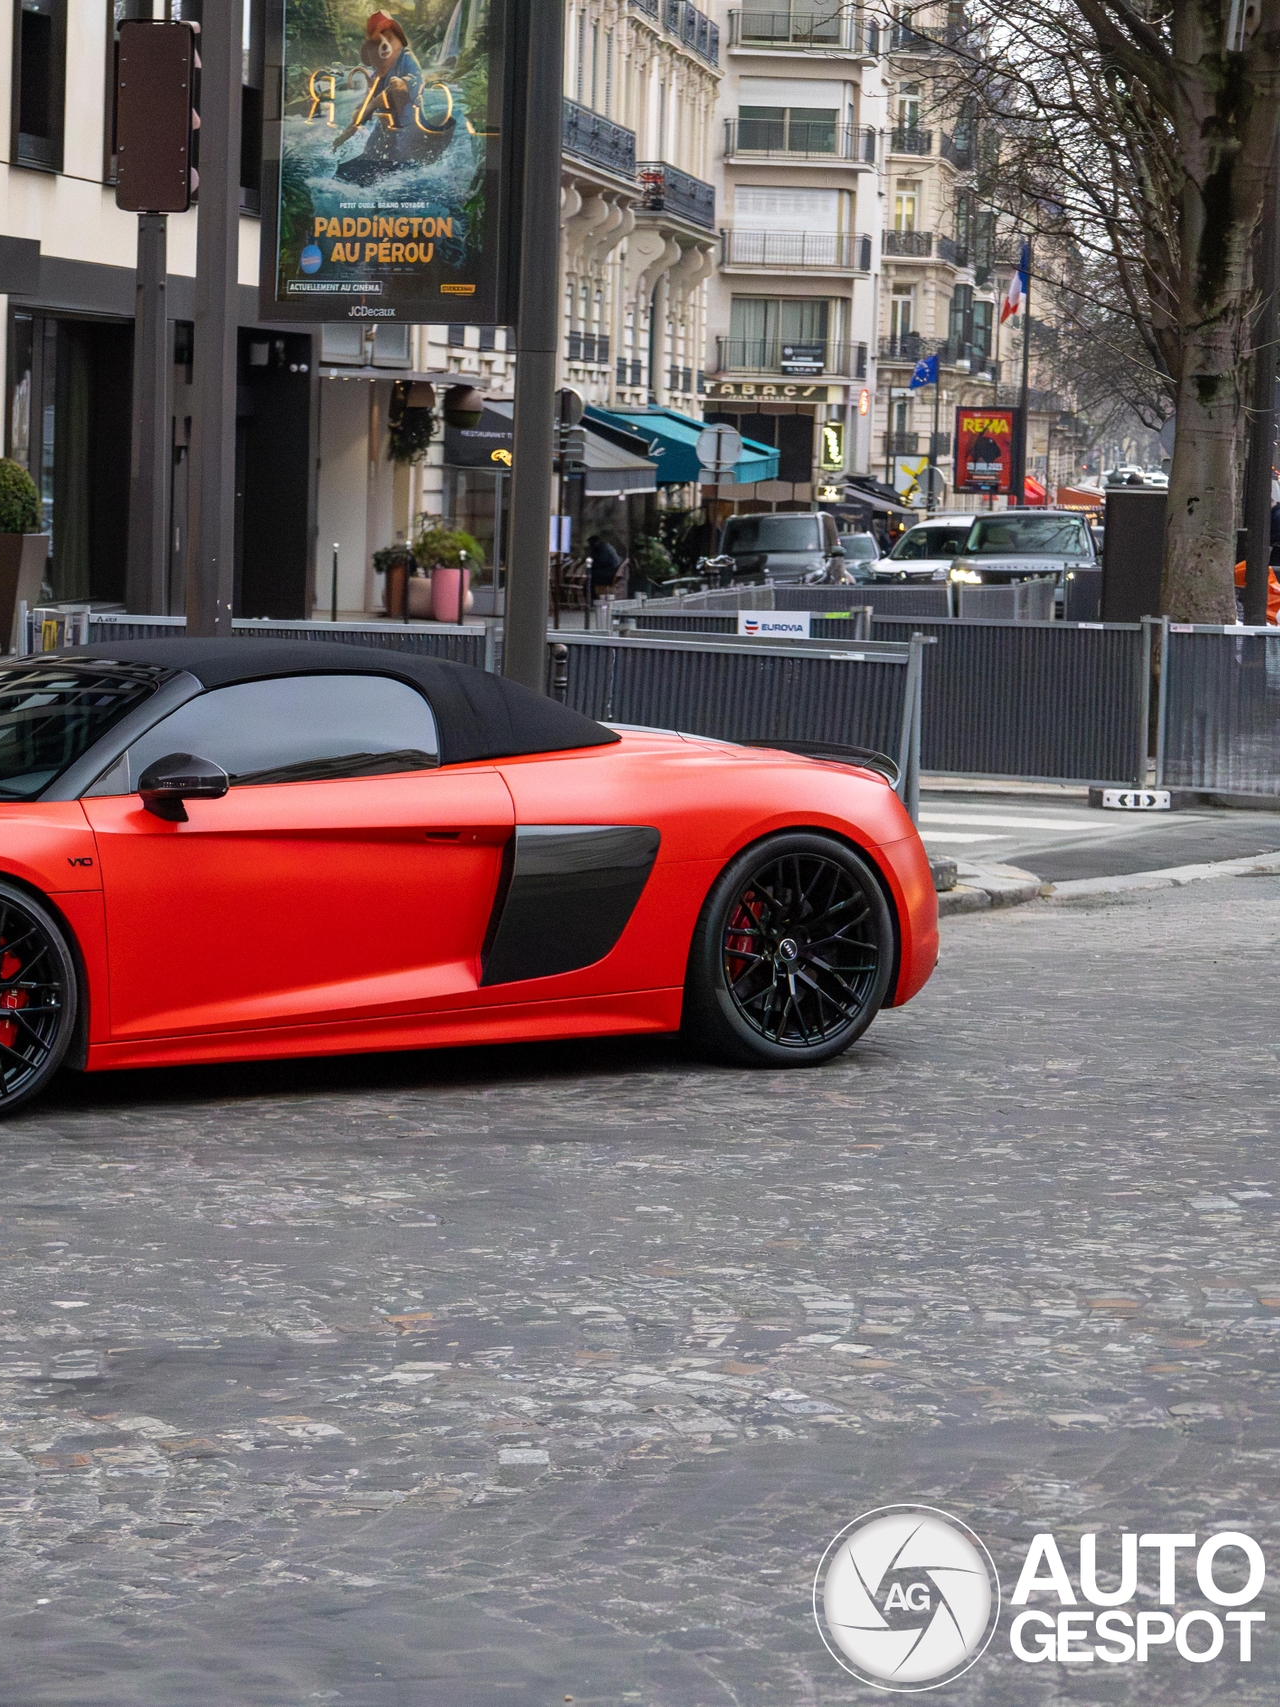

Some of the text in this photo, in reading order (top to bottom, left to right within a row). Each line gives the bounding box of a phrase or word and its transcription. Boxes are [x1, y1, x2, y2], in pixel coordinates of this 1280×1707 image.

[330, 242, 361, 264] AU
[364, 238, 435, 264] PÉROU
[289, 283, 340, 291] ACTUELLEMENT
[347, 305, 396, 317] JCDecaux
[761, 623, 804, 632] EUROVIA
[67, 857, 94, 867] V10
